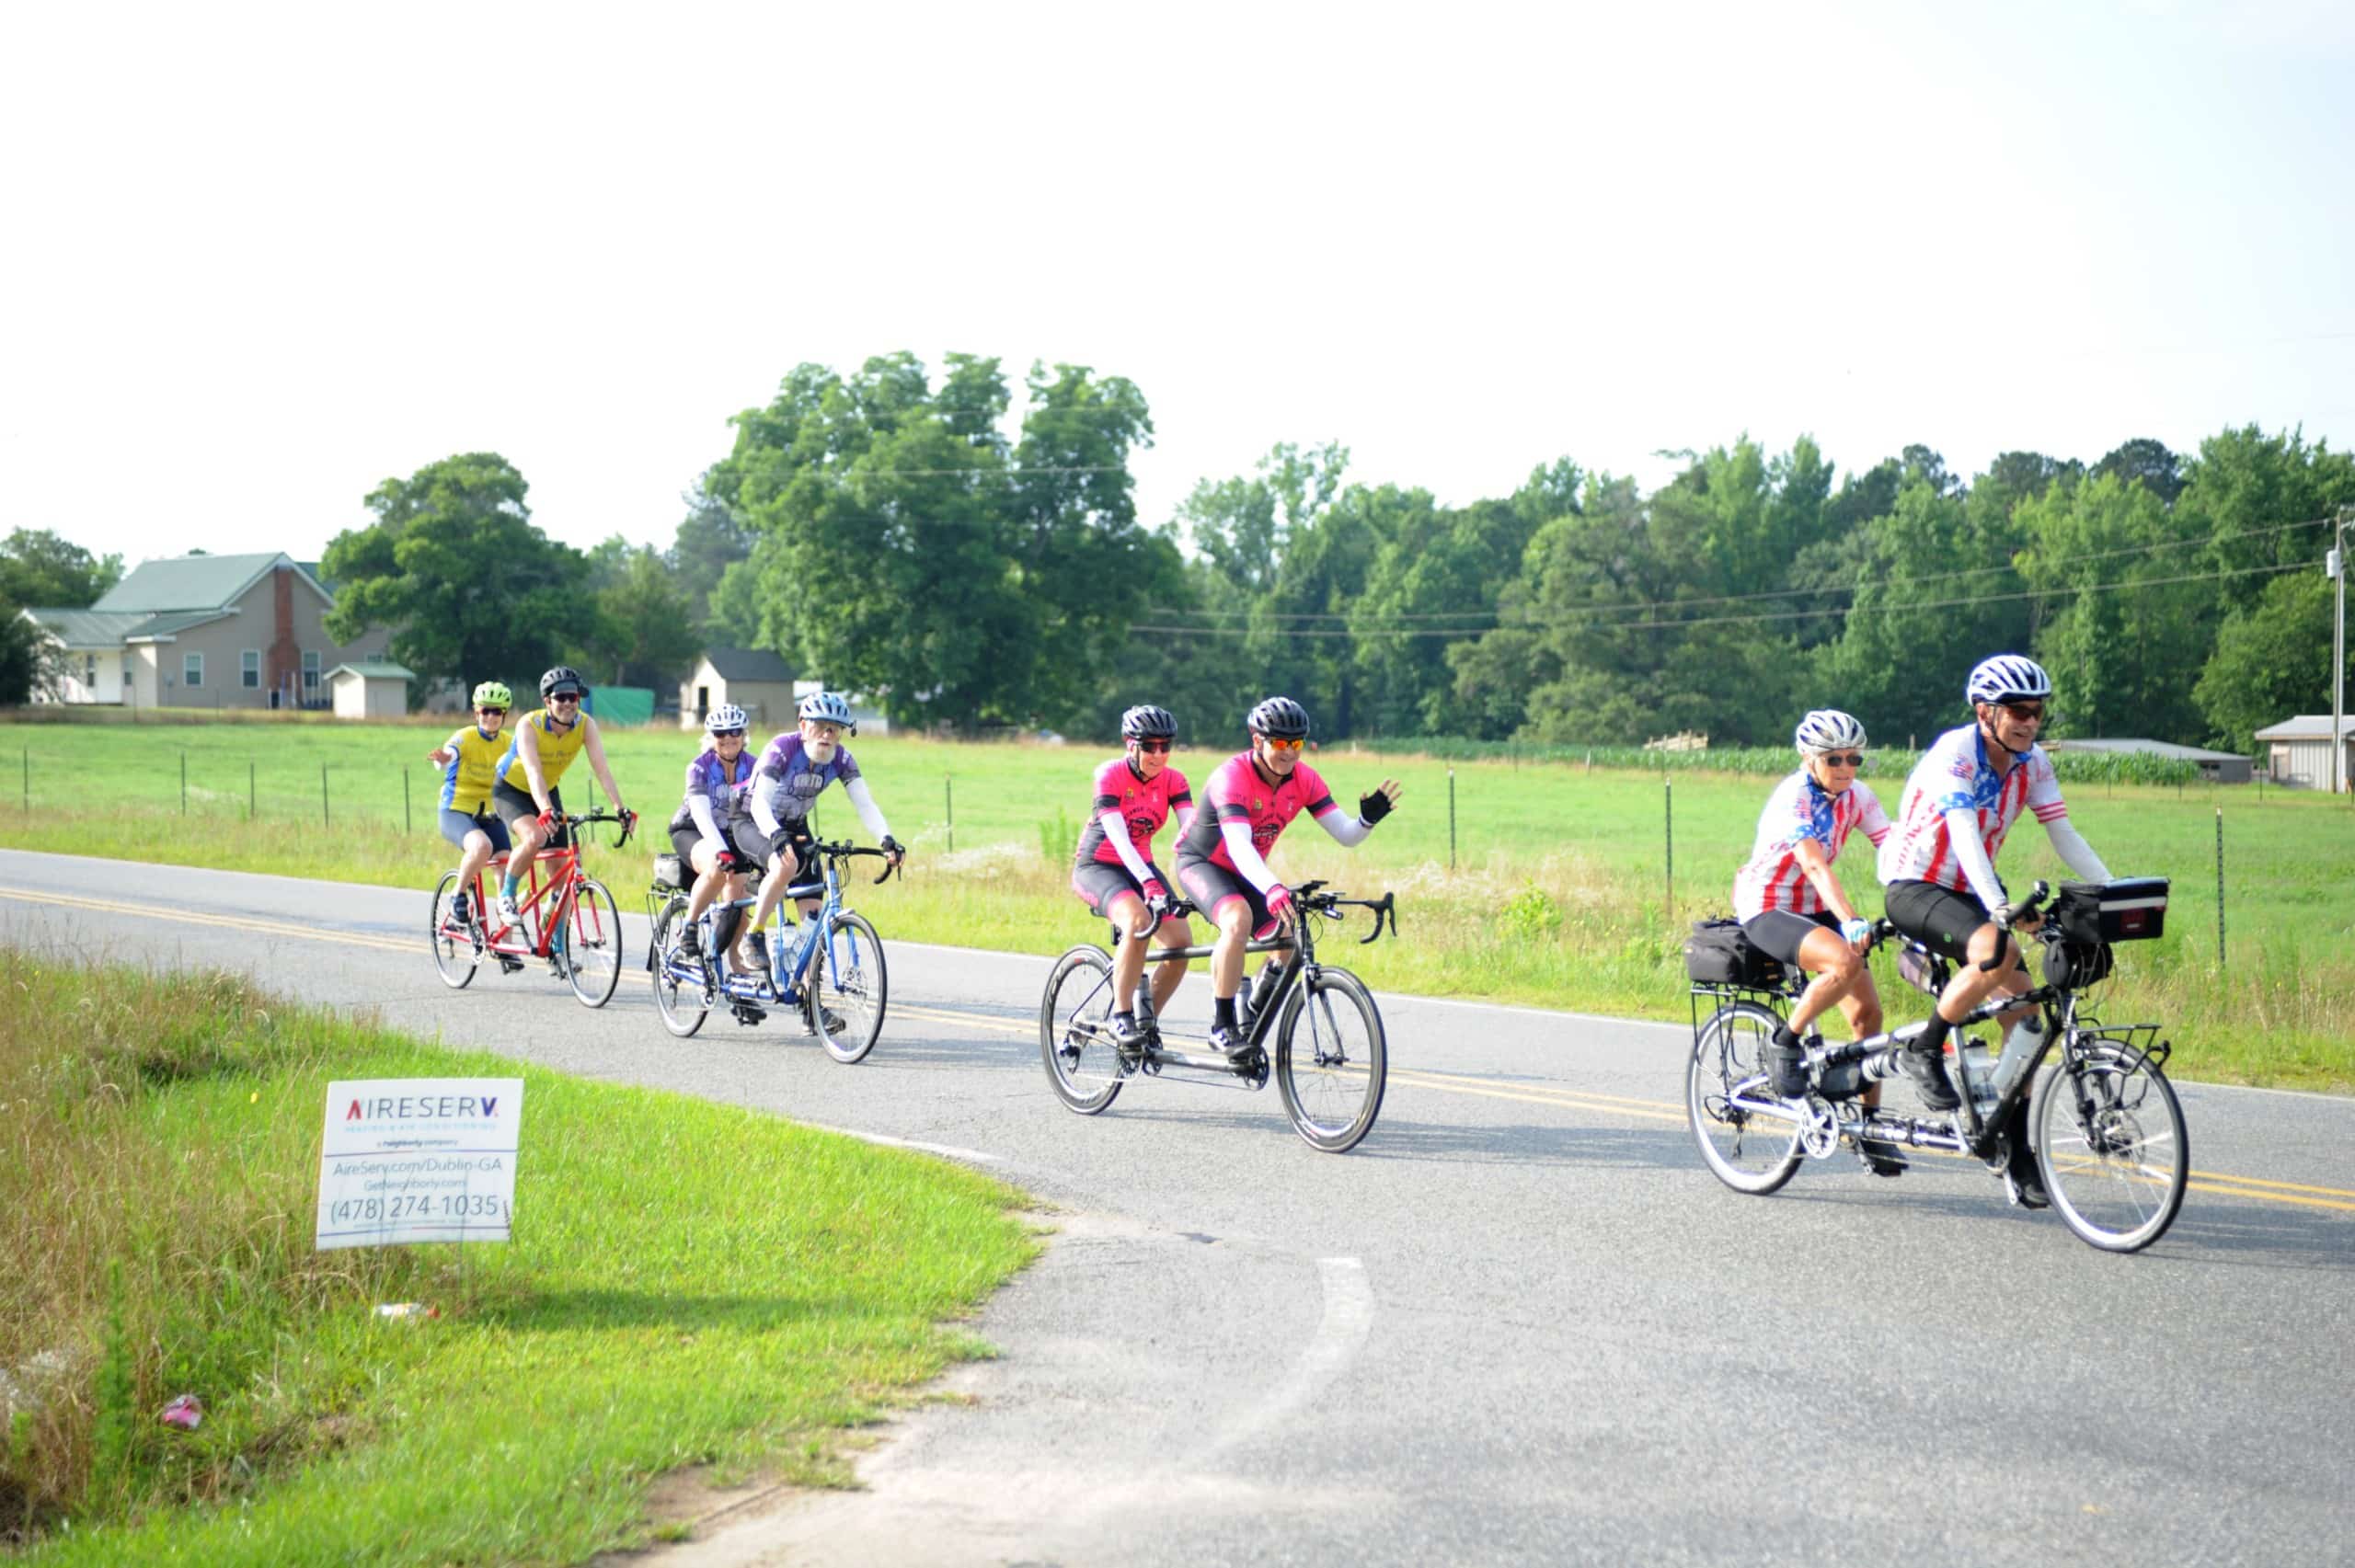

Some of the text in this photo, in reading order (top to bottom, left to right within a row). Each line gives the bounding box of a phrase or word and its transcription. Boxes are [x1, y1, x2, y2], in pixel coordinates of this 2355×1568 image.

[347, 1097, 498, 1119] AIRESERV
[330, 1195, 498, 1226] (478) 274-1035
